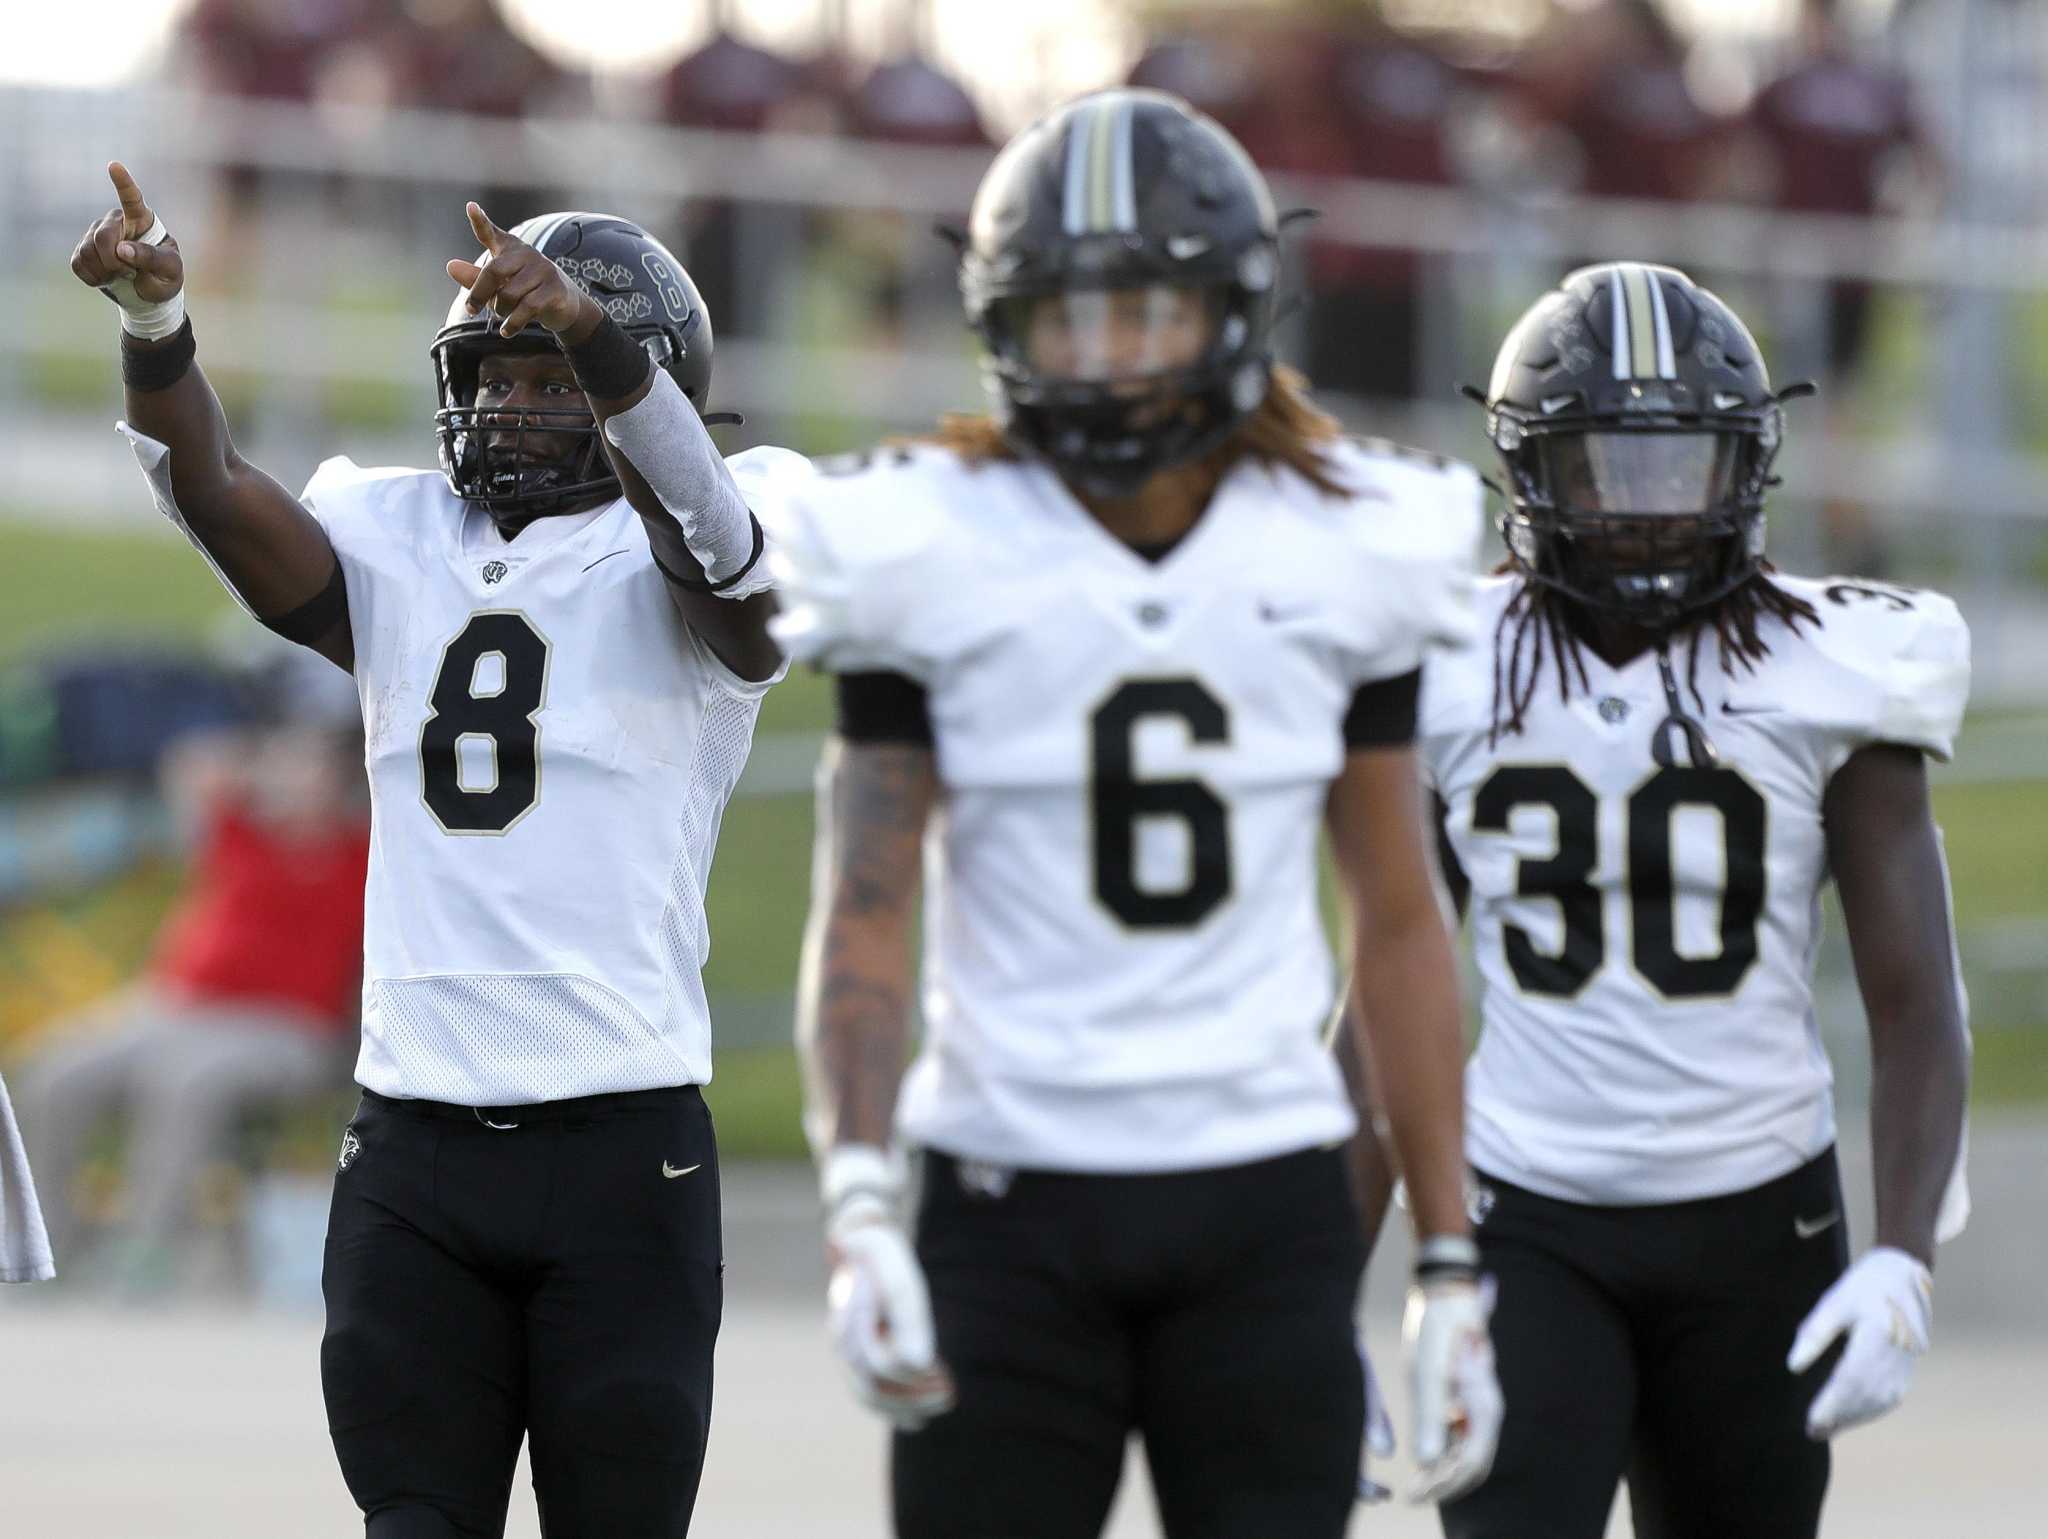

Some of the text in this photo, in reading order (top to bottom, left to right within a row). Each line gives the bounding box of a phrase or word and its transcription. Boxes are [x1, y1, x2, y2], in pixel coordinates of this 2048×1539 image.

[641, 251, 690, 322] 8
[416, 608, 553, 836] 8
[1090, 675, 1234, 933] 6
[1472, 761, 1768, 1000] 30
